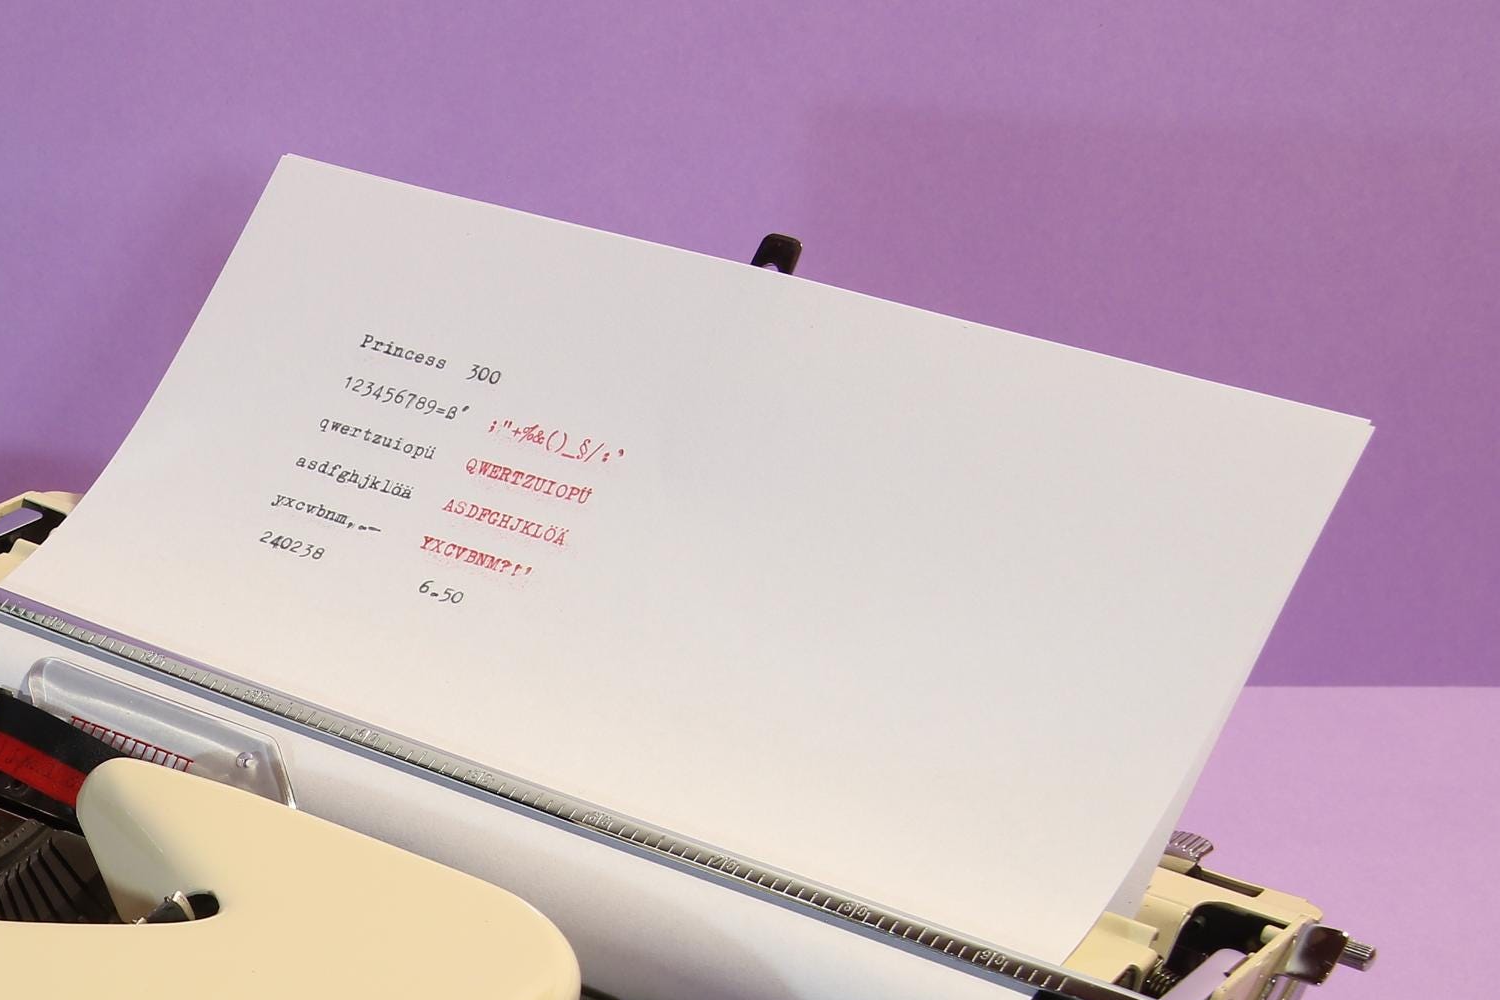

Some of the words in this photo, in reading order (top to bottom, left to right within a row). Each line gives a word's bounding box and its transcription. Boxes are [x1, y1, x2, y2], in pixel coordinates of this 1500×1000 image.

[360, 334, 447, 369] Princess
[466, 364, 502, 385] 300
[319, 418, 437, 460] qwertzuiopü
[466, 458, 593, 504] QWERTZUIOPÜ
[296, 456, 414, 500] asdfghjklöä
[442, 499, 570, 546] ASDFGHJKLÖÄ
[259, 531, 325, 560] 240238
